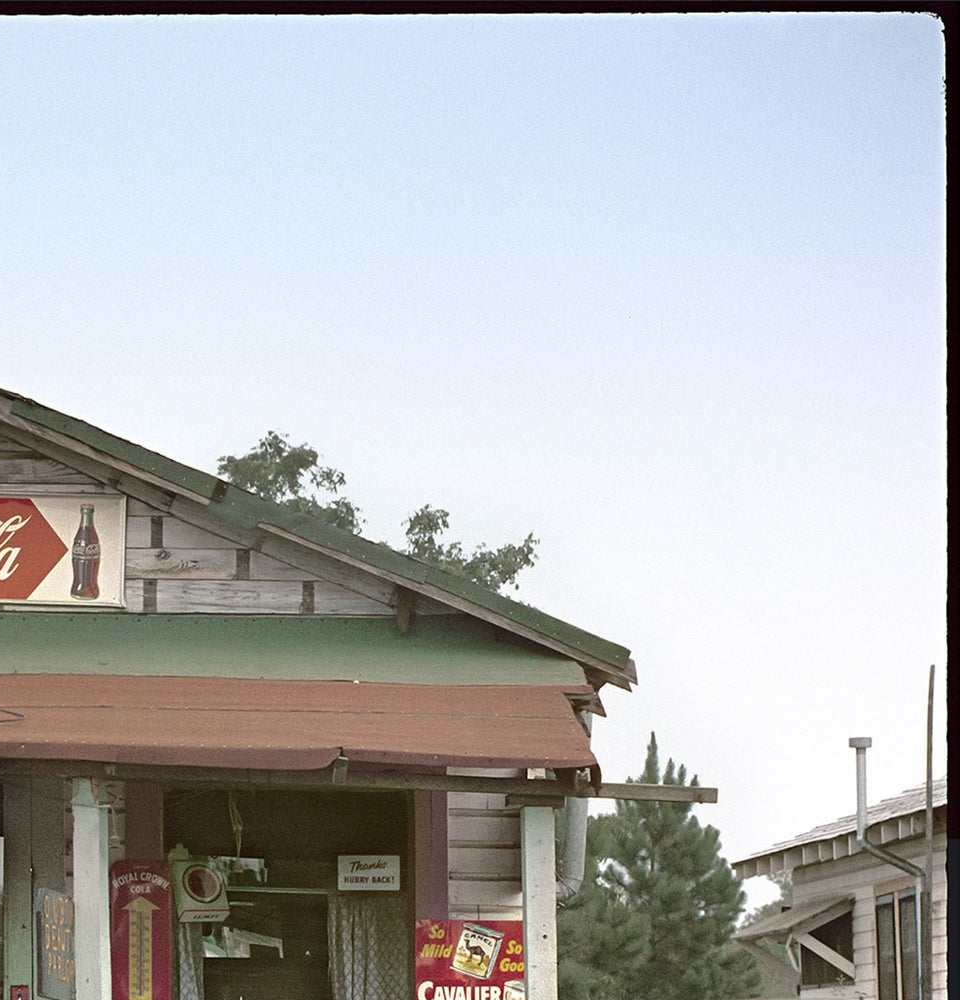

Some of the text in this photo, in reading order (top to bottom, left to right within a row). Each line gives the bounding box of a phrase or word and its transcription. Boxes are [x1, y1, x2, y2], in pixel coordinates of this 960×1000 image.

[350, 859, 387, 872] Thanks
[112, 872, 170, 891] ROYAL CROWN
[372, 876, 394, 884] BACK!
[130, 885, 151, 894] COLA
[429, 924, 445, 939] So
[464, 932, 492, 947] CAMEL
[421, 944, 453, 958] Mild
[506, 940, 523, 955] So
[500, 957, 524, 972] Goo
